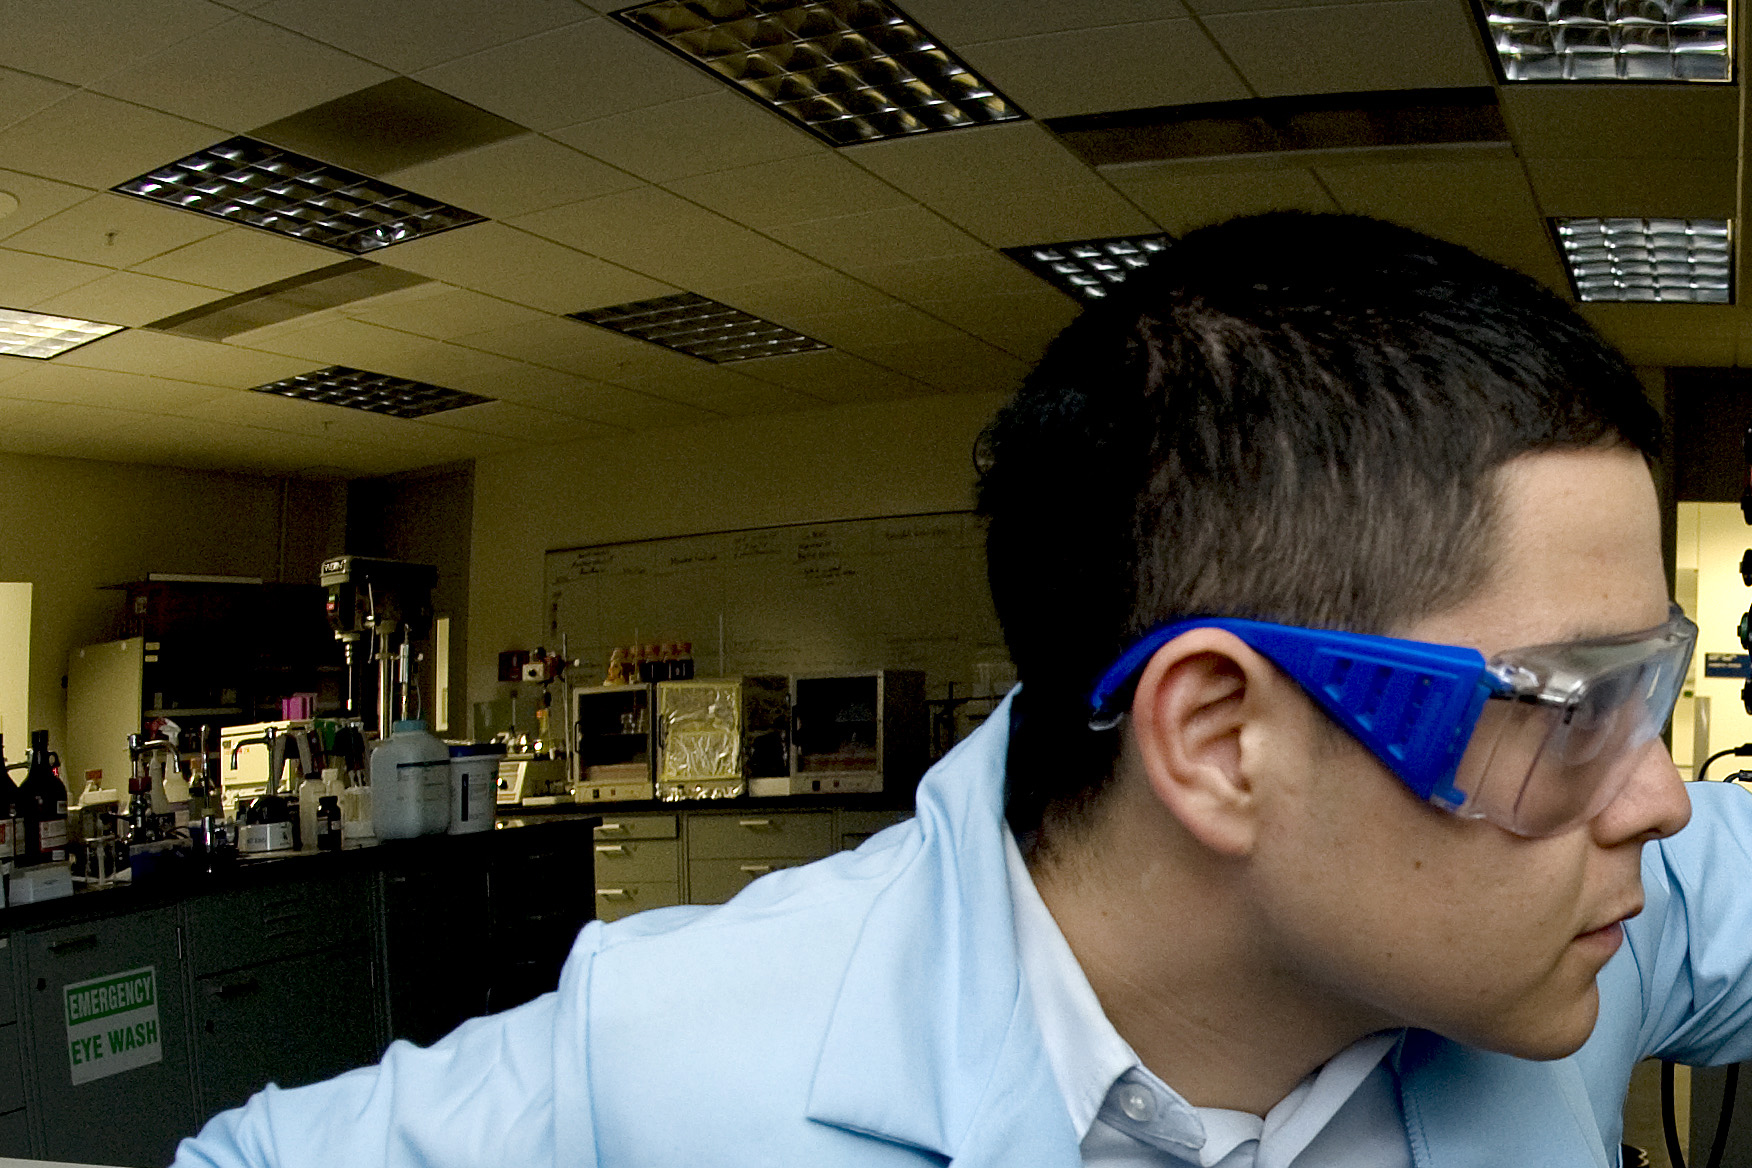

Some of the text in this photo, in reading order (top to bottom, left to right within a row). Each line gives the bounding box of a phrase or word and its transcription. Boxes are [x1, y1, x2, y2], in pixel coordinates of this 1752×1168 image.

[69, 976, 151, 1019] EMERGENCY
[71, 1020, 158, 1065] EYE WASH
